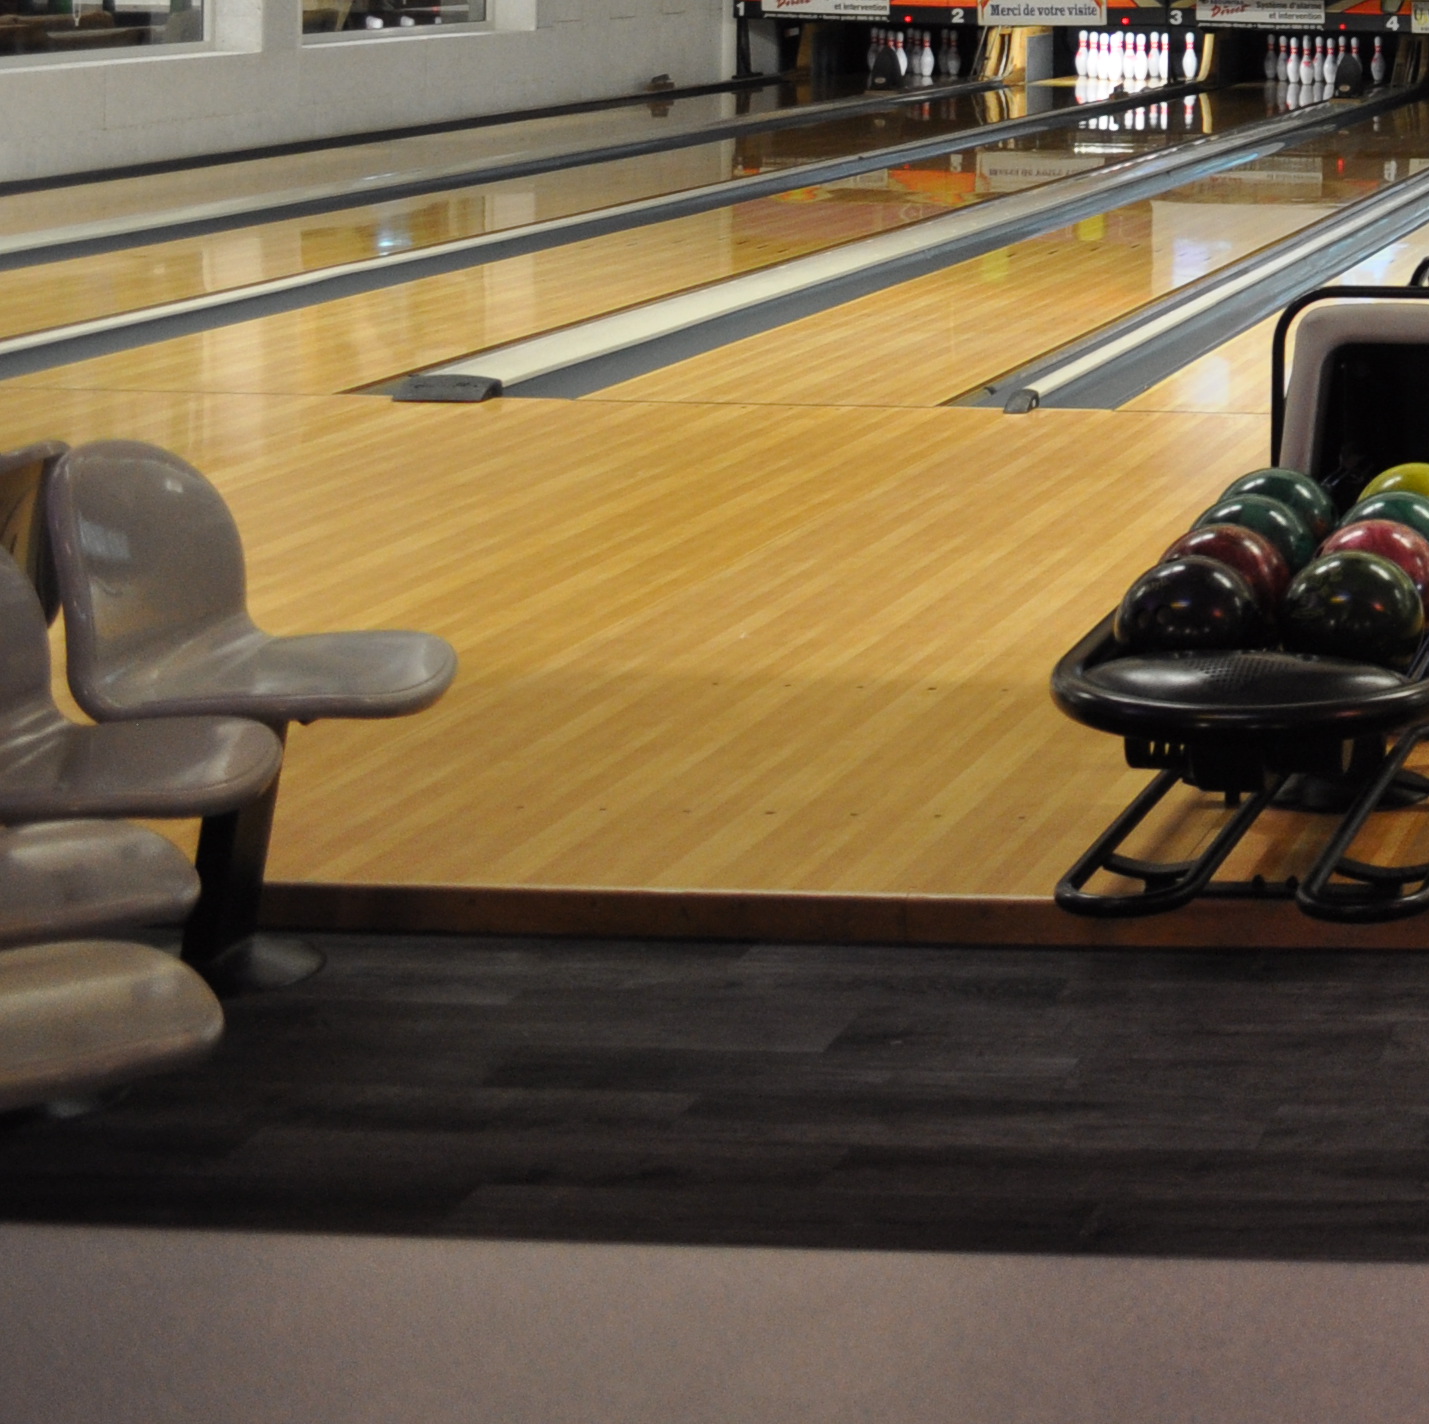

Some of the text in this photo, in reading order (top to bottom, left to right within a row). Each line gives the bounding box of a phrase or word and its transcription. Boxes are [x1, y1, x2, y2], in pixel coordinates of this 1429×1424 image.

[736, 1, 745, 16] 1
[951, 8, 965, 23] 2
[990, 4, 1097, 16] Merci votre visite
[1169, 10, 1182, 25] 3
[1386, 16, 1400, 31] 4
